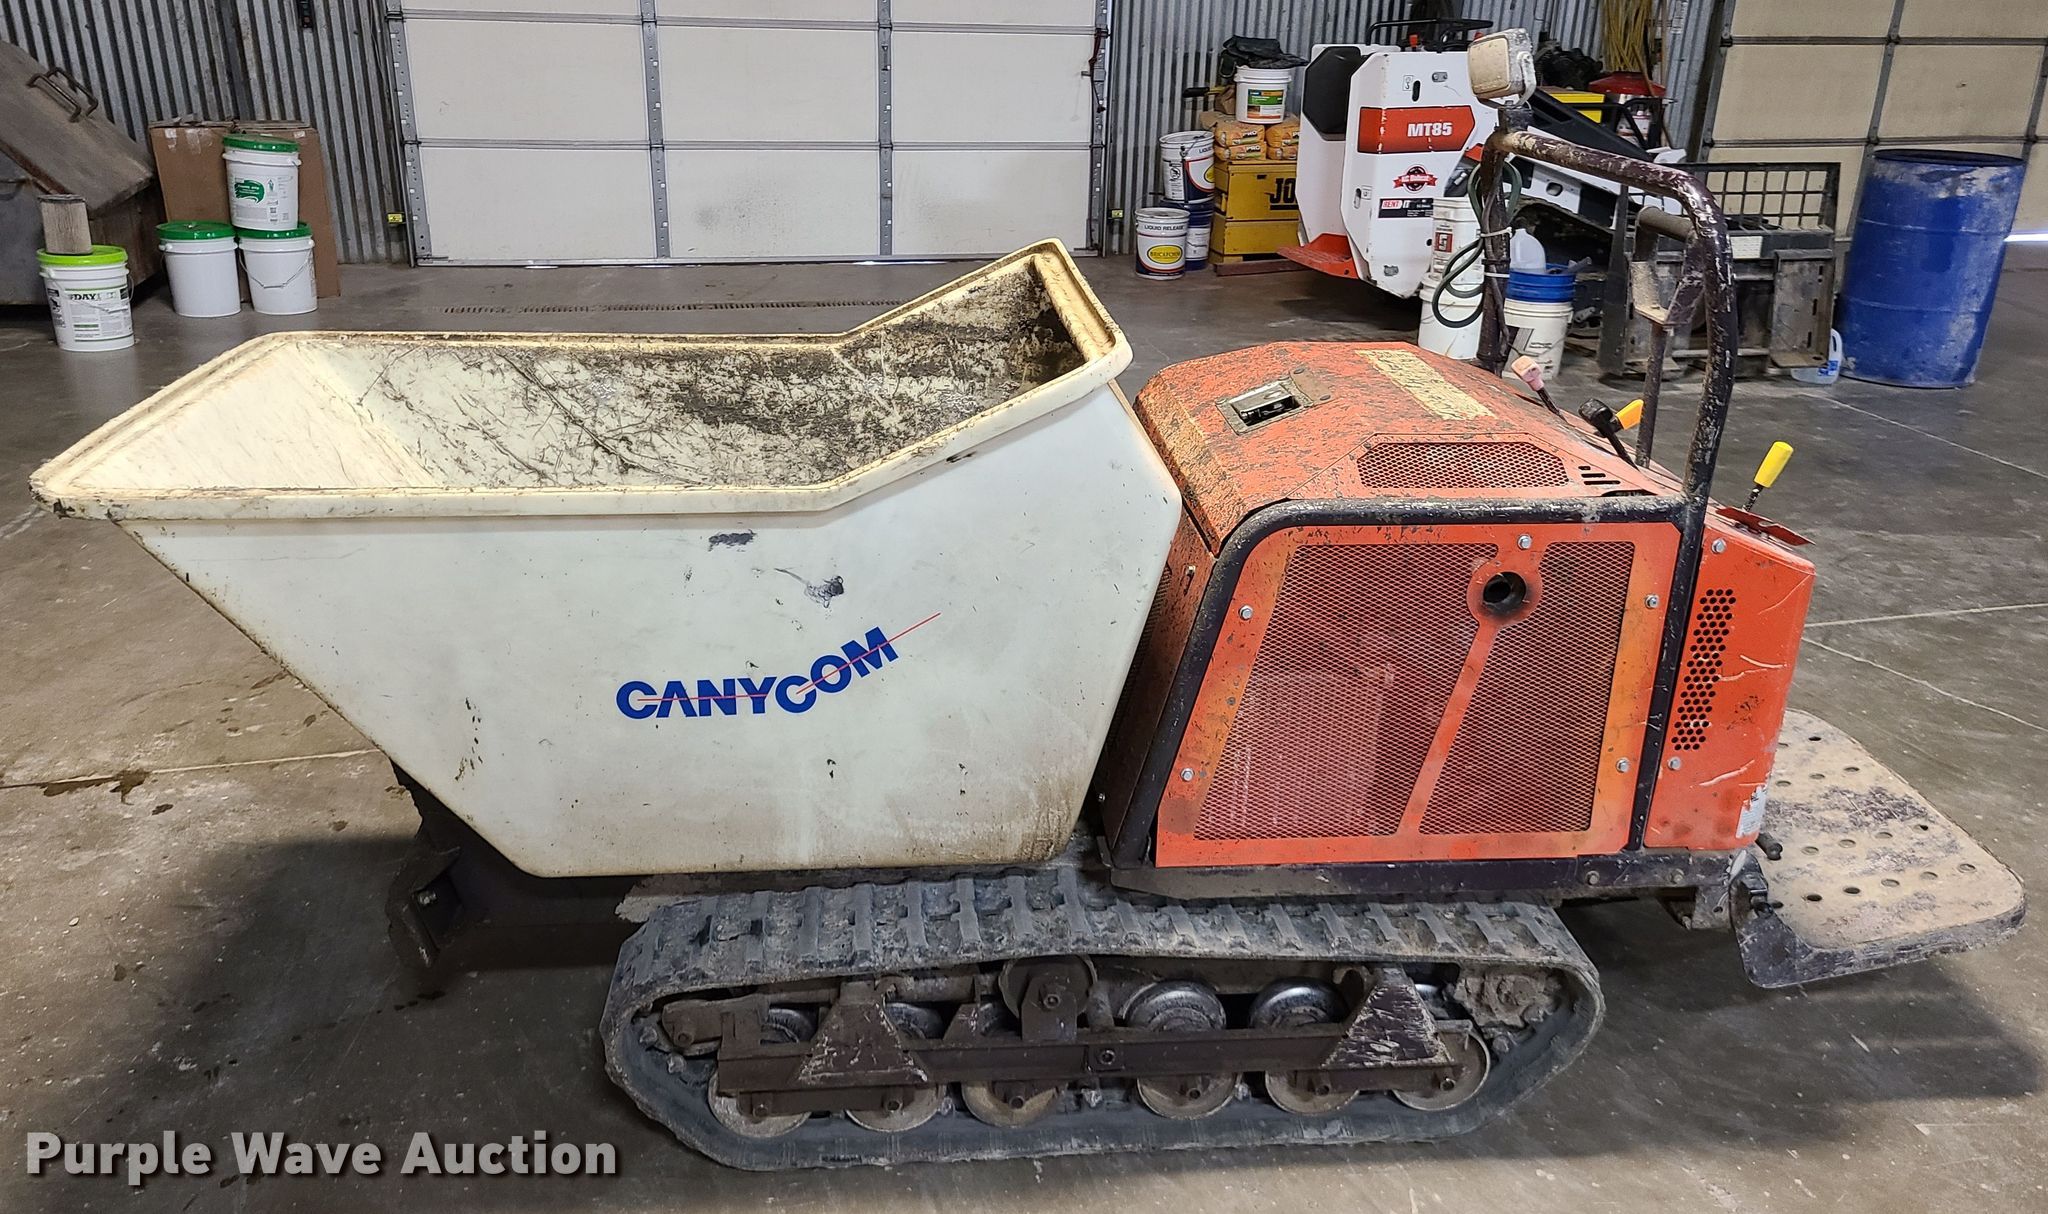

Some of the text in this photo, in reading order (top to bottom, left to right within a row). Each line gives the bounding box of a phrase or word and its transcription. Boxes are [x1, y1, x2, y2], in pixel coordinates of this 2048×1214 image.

[1407, 122, 1453, 137] MT85
[1269, 177, 1297, 204] JO
[616, 626, 899, 719] CANYCOM
